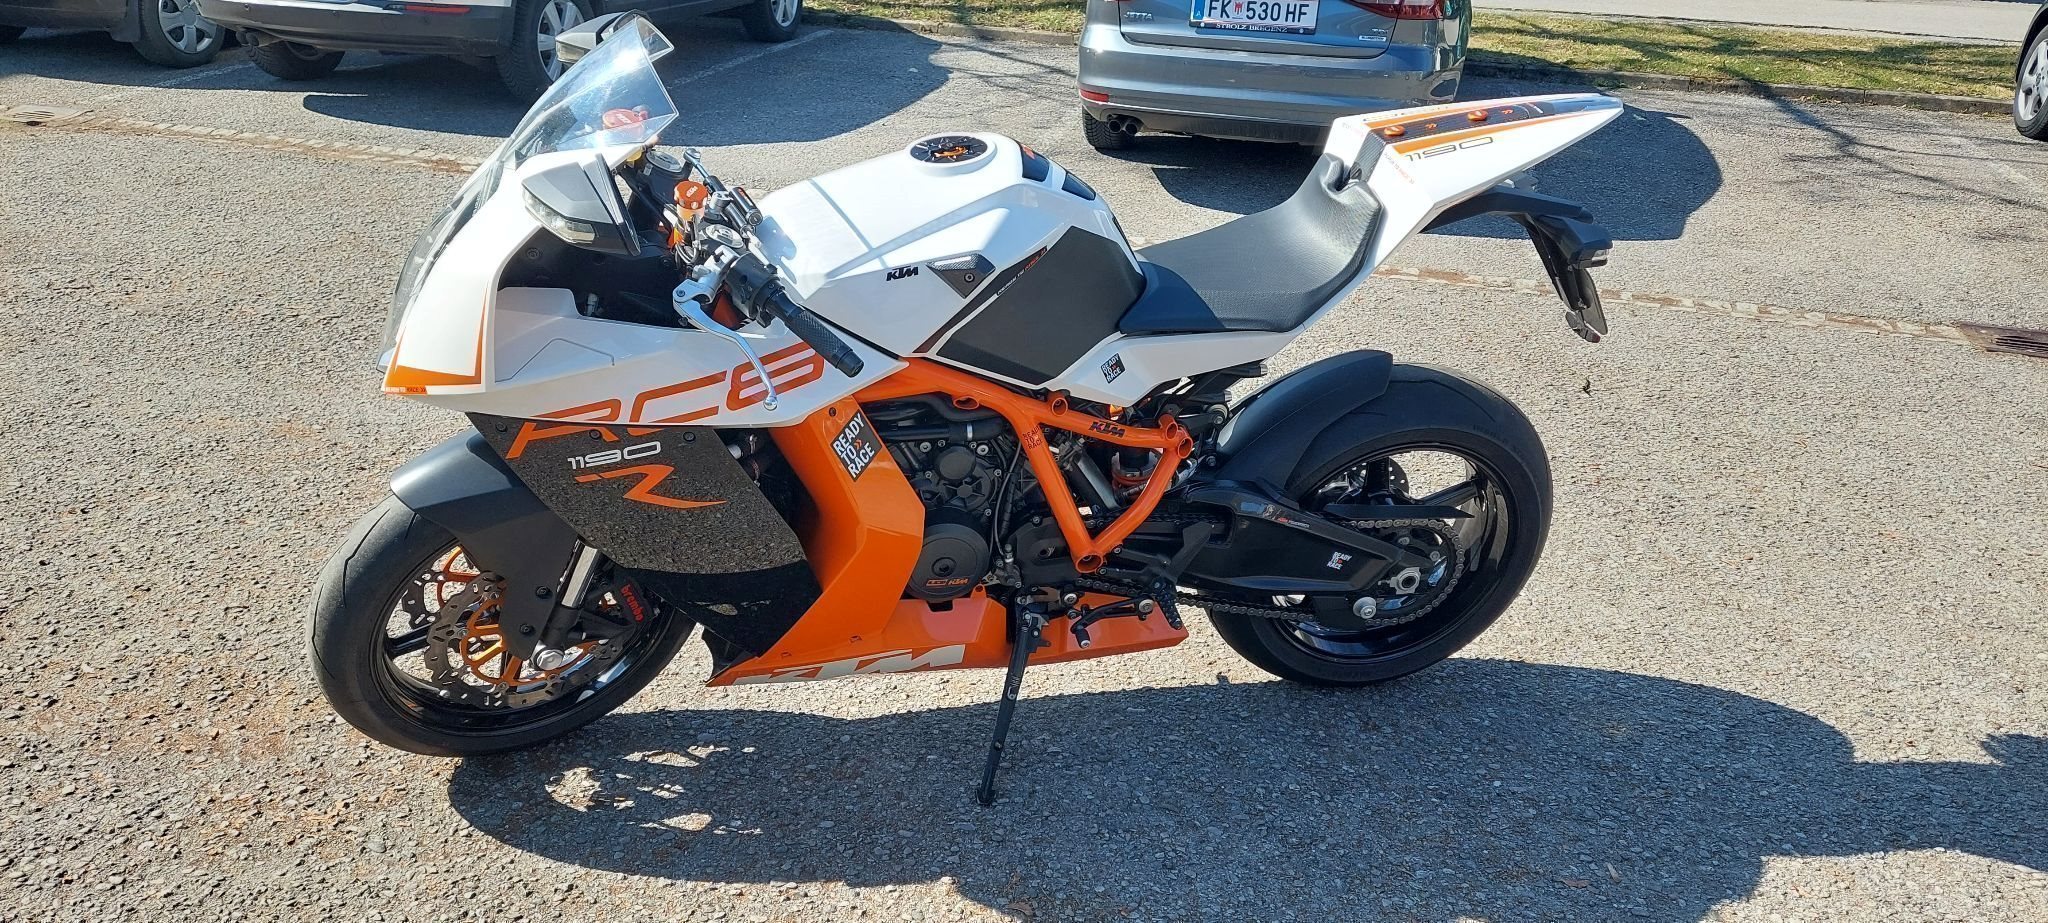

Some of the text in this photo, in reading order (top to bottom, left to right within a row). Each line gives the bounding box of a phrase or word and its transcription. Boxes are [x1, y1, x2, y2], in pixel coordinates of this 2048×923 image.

[1208, 0, 1310, 23] FK 530 HF
[1215, 22, 1288, 33] STROLZ BREGENZ
[1405, 136, 1494, 161] 1190
[886, 265, 919, 281] KTM
[832, 412, 865, 456] READY
[1088, 420, 1126, 438] KTM
[567, 441, 662, 470] 1190
[841, 445, 857, 465] TO
[847, 442, 875, 478] RACE
[620, 584, 644, 623] brembo
